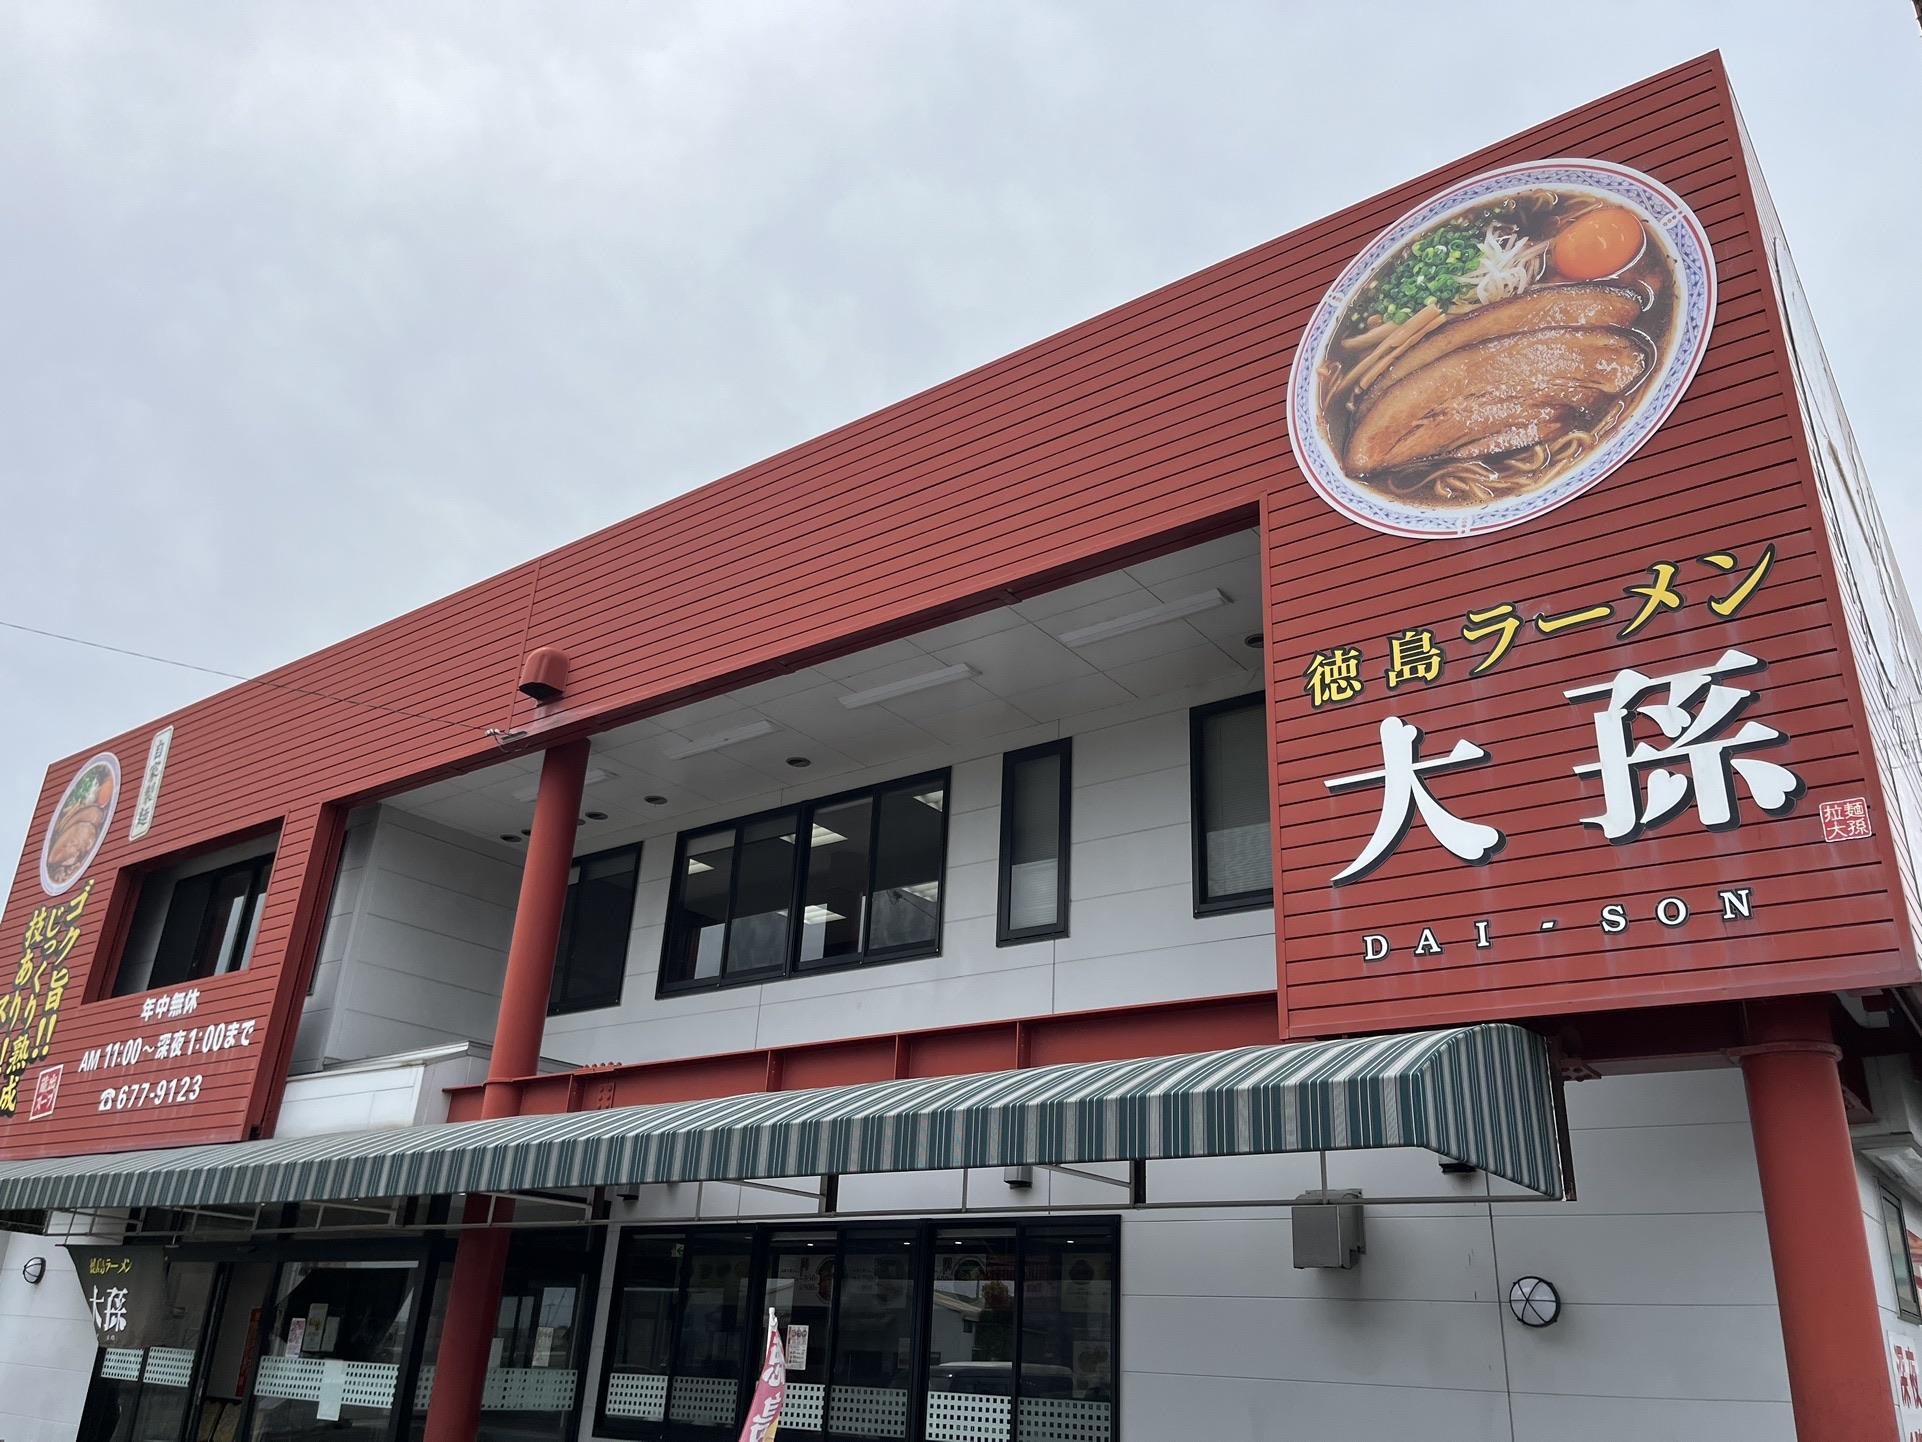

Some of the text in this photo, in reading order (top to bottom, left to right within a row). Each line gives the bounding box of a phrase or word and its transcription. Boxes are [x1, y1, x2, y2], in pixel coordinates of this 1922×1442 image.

[1304, 543, 1777, 708] 徳島ラーメン
[1323, 649, 1806, 888] 大孫
[0, 906, 64, 1112] じっくり熟成
[140, 988, 200, 1022] 年中無休
[116, 1074, 203, 1110] 677-9123
